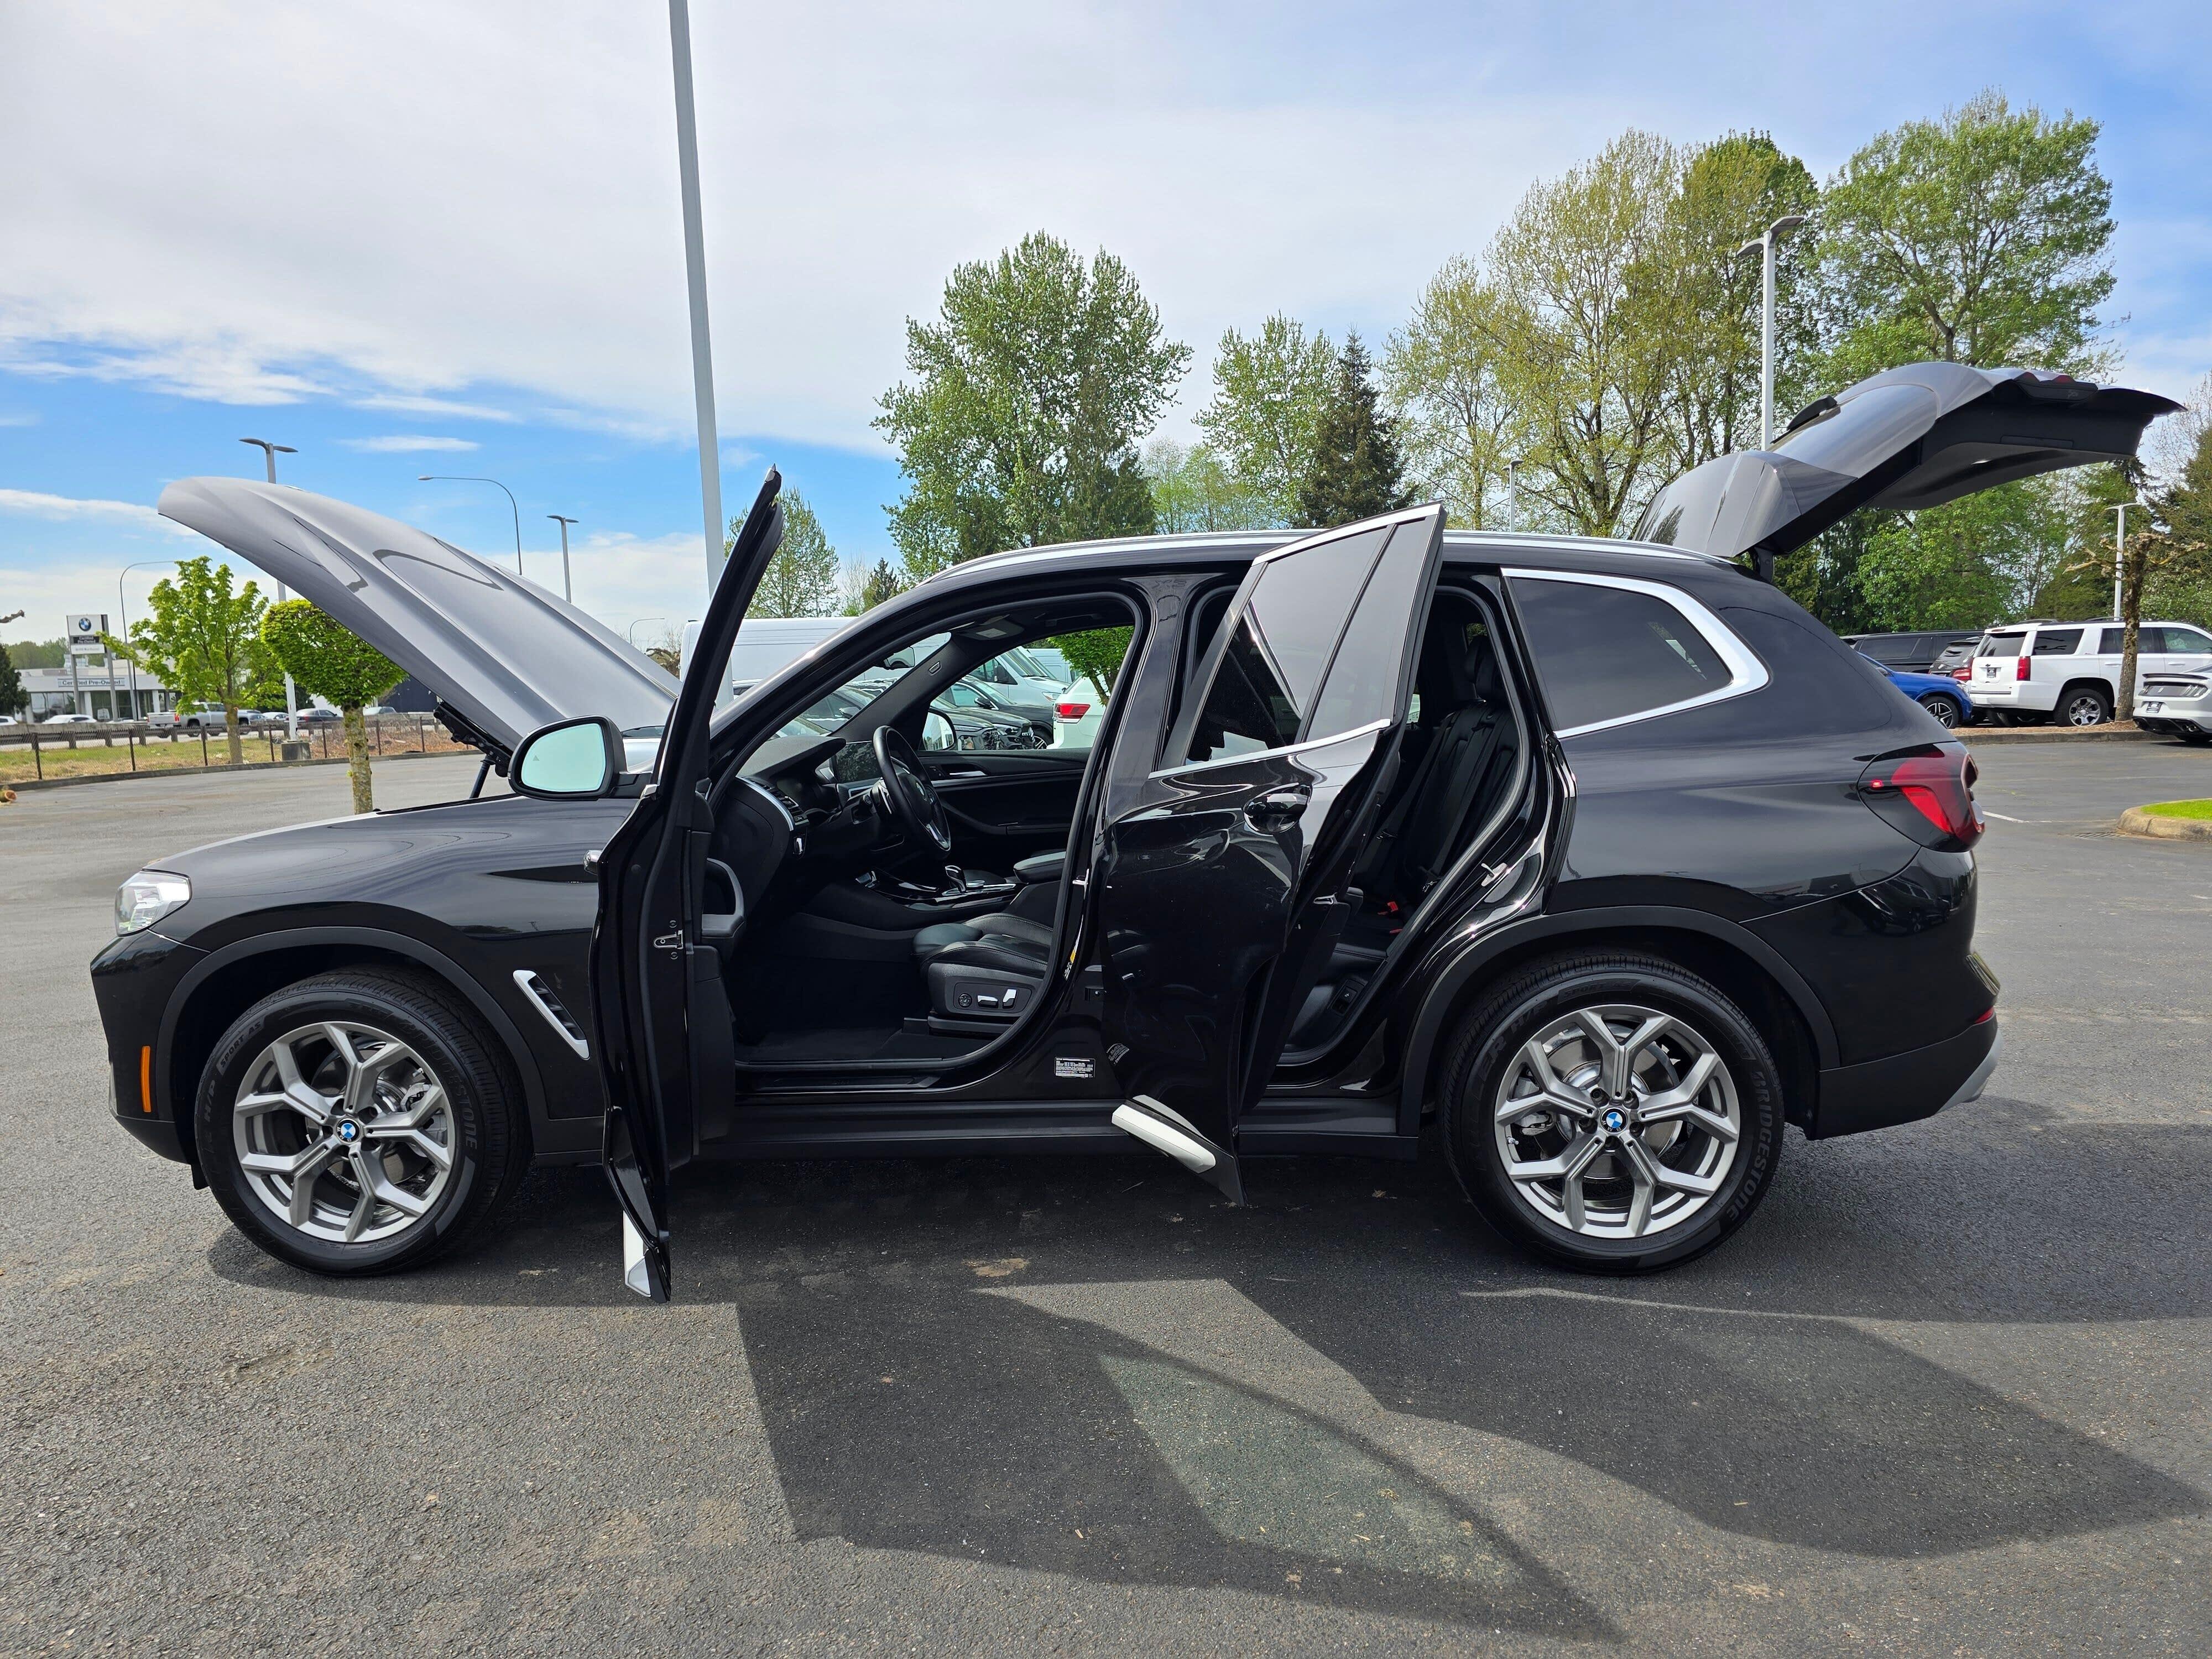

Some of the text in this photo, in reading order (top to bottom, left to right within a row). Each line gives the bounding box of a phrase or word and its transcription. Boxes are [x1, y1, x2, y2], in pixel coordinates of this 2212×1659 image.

[204, 1021, 261, 1123] H/P SPORT AS
[1726, 1071, 1772, 1222] BRIDGESTONE
